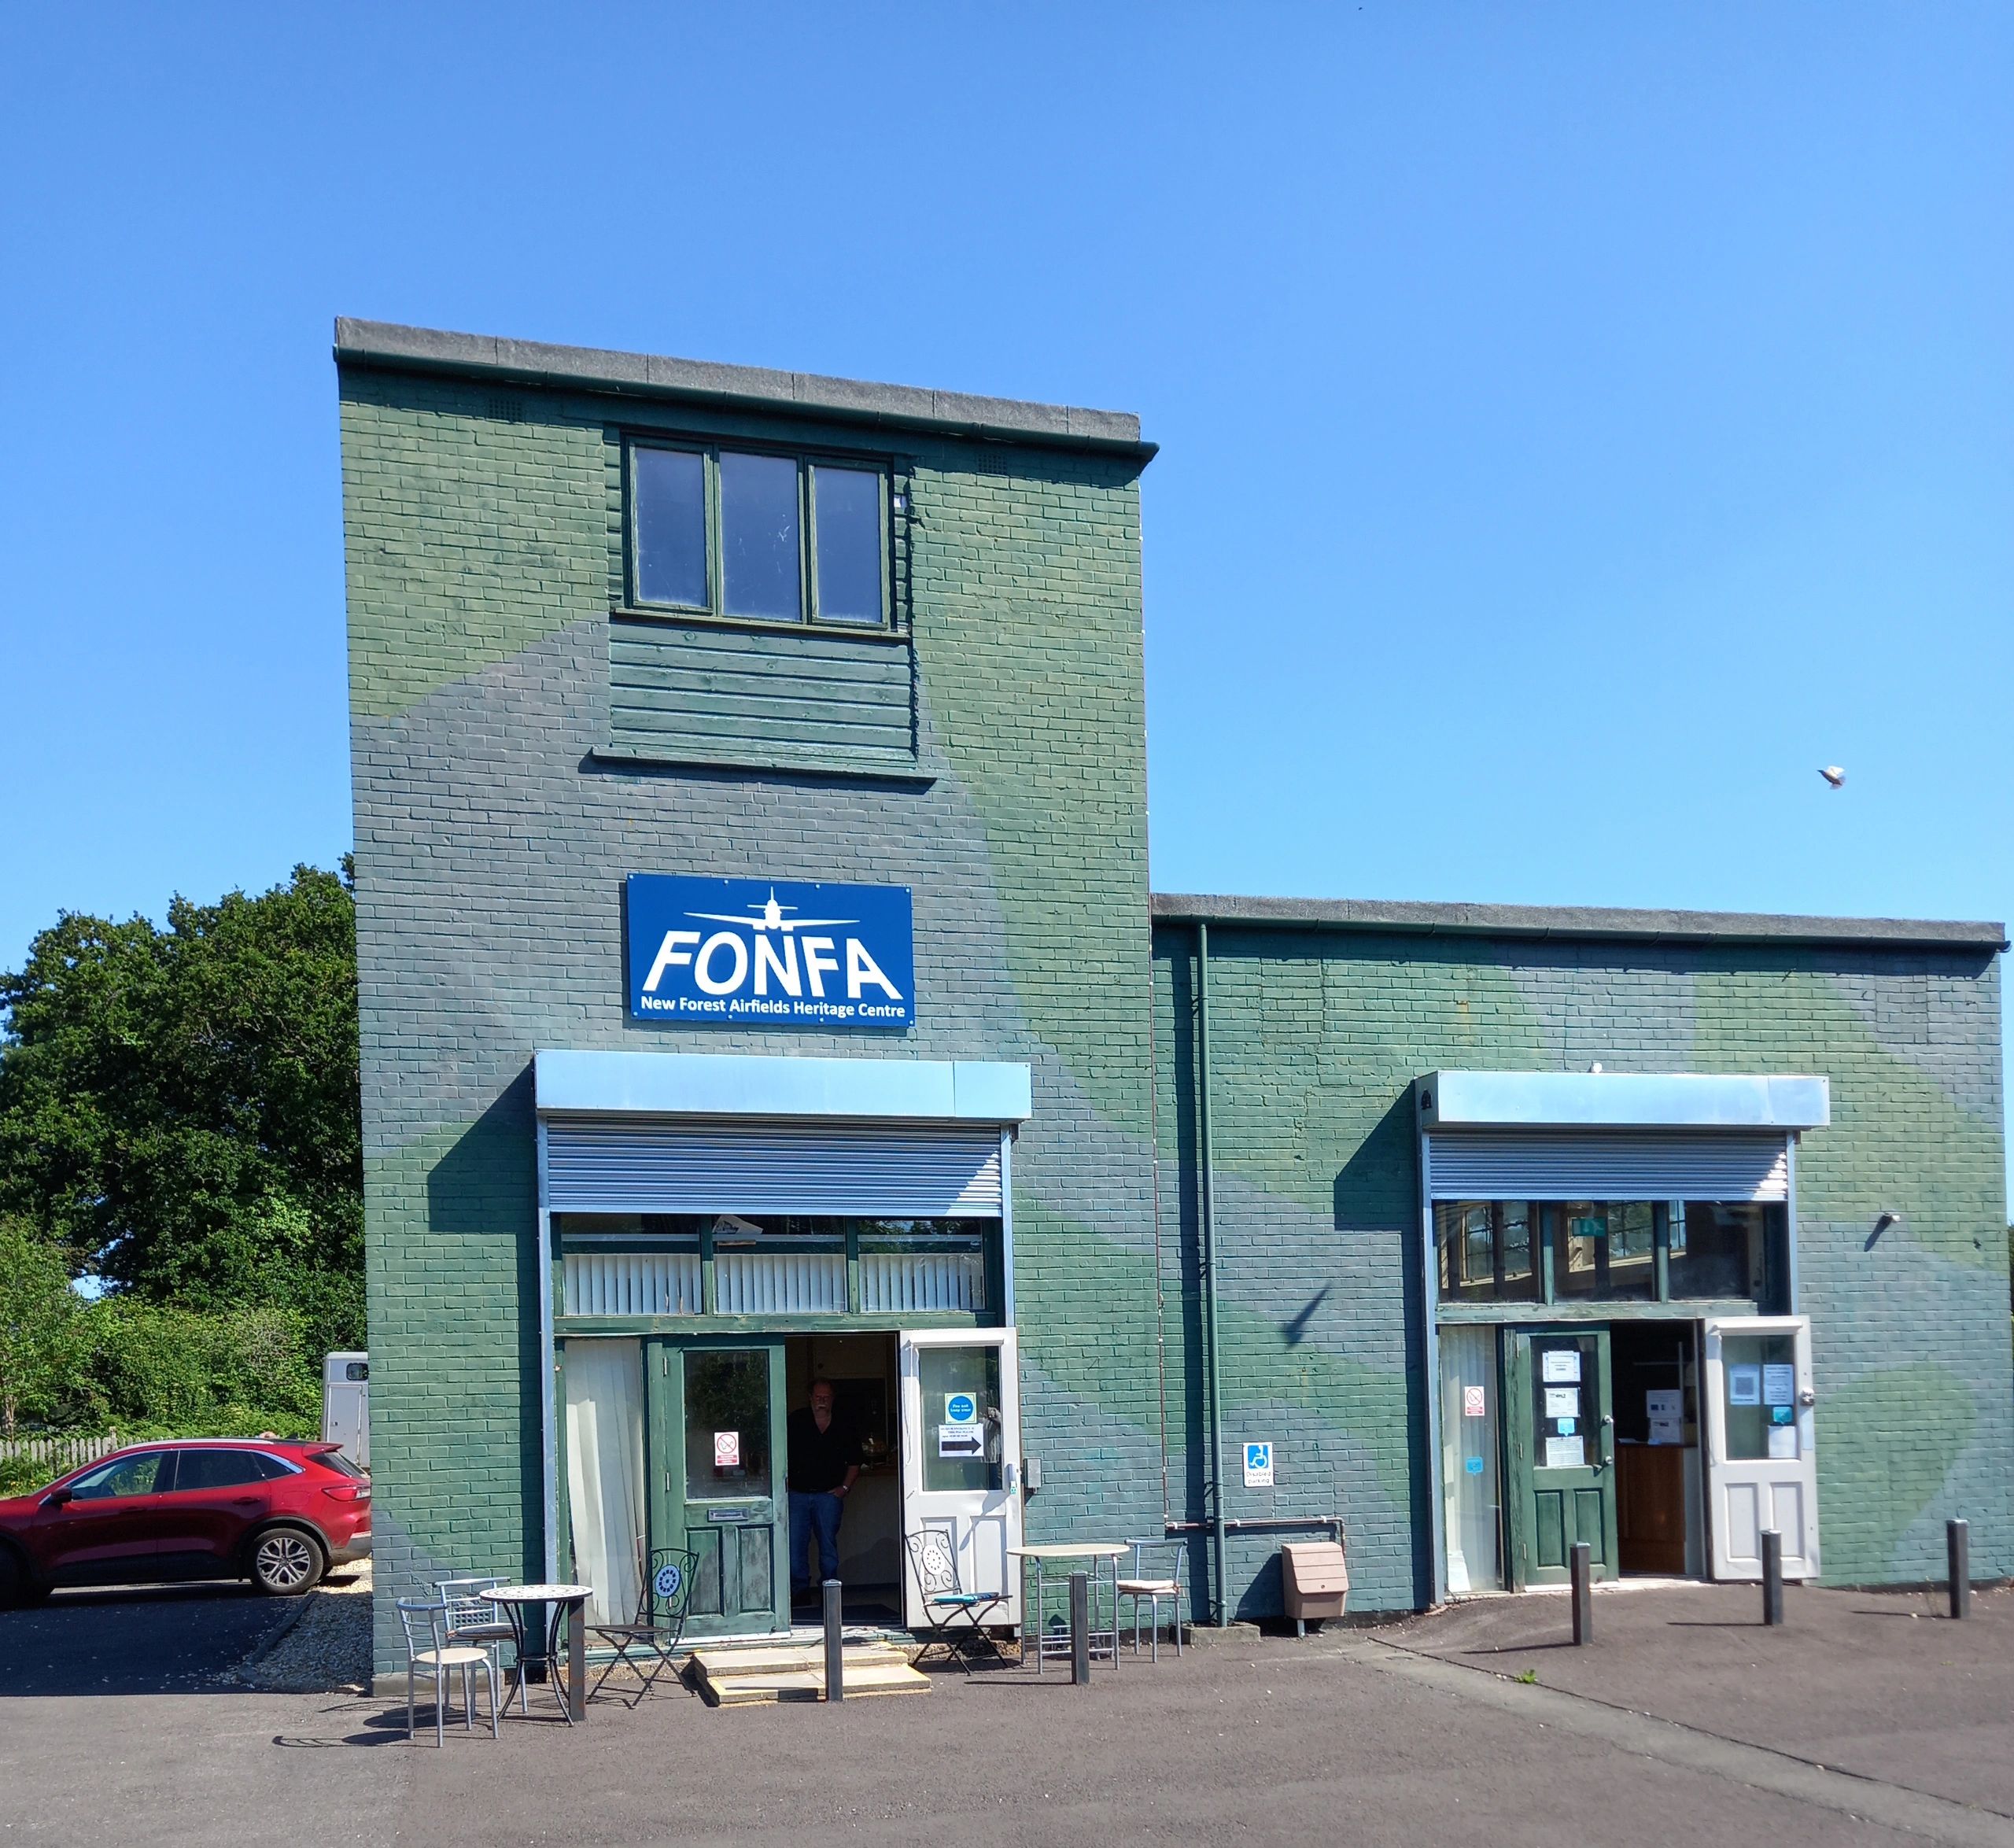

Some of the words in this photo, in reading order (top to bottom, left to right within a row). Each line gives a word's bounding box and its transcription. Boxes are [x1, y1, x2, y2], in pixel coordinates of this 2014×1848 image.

[642, 930, 904, 1000] FONFA
[641, 996, 676, 1010] New
[680, 997, 726, 1013] Forest
[729, 998, 790, 1014] Airfields
[794, 1001, 854, 1018] Heritage
[858, 1003, 906, 1017] Centre
